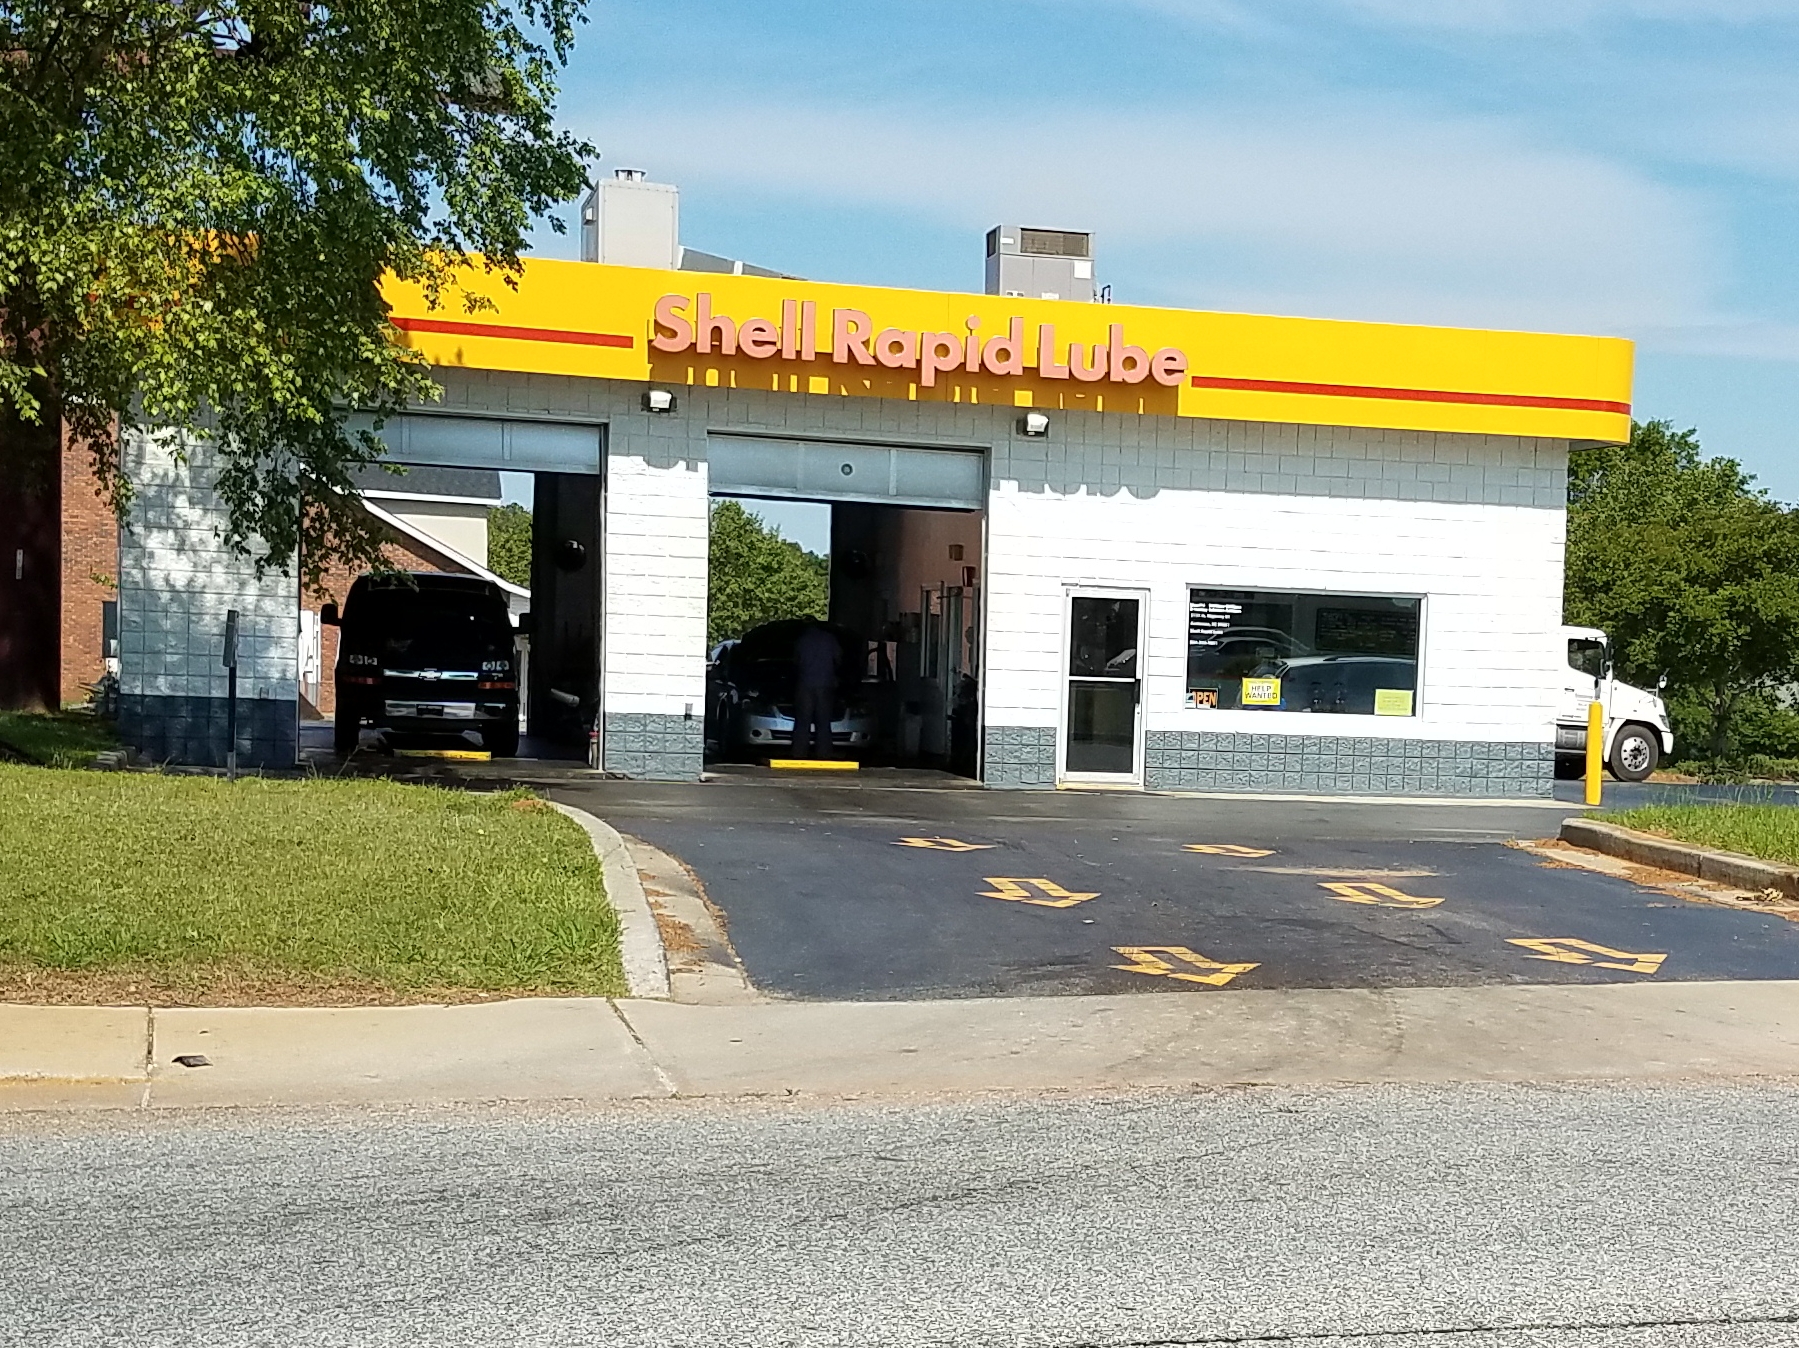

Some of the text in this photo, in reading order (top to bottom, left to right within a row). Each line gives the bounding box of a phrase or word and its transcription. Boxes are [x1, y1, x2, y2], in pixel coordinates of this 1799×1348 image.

[651, 293, 1189, 387] Shell Rapid Lube
[1244, 691, 1278, 699] WANTED
